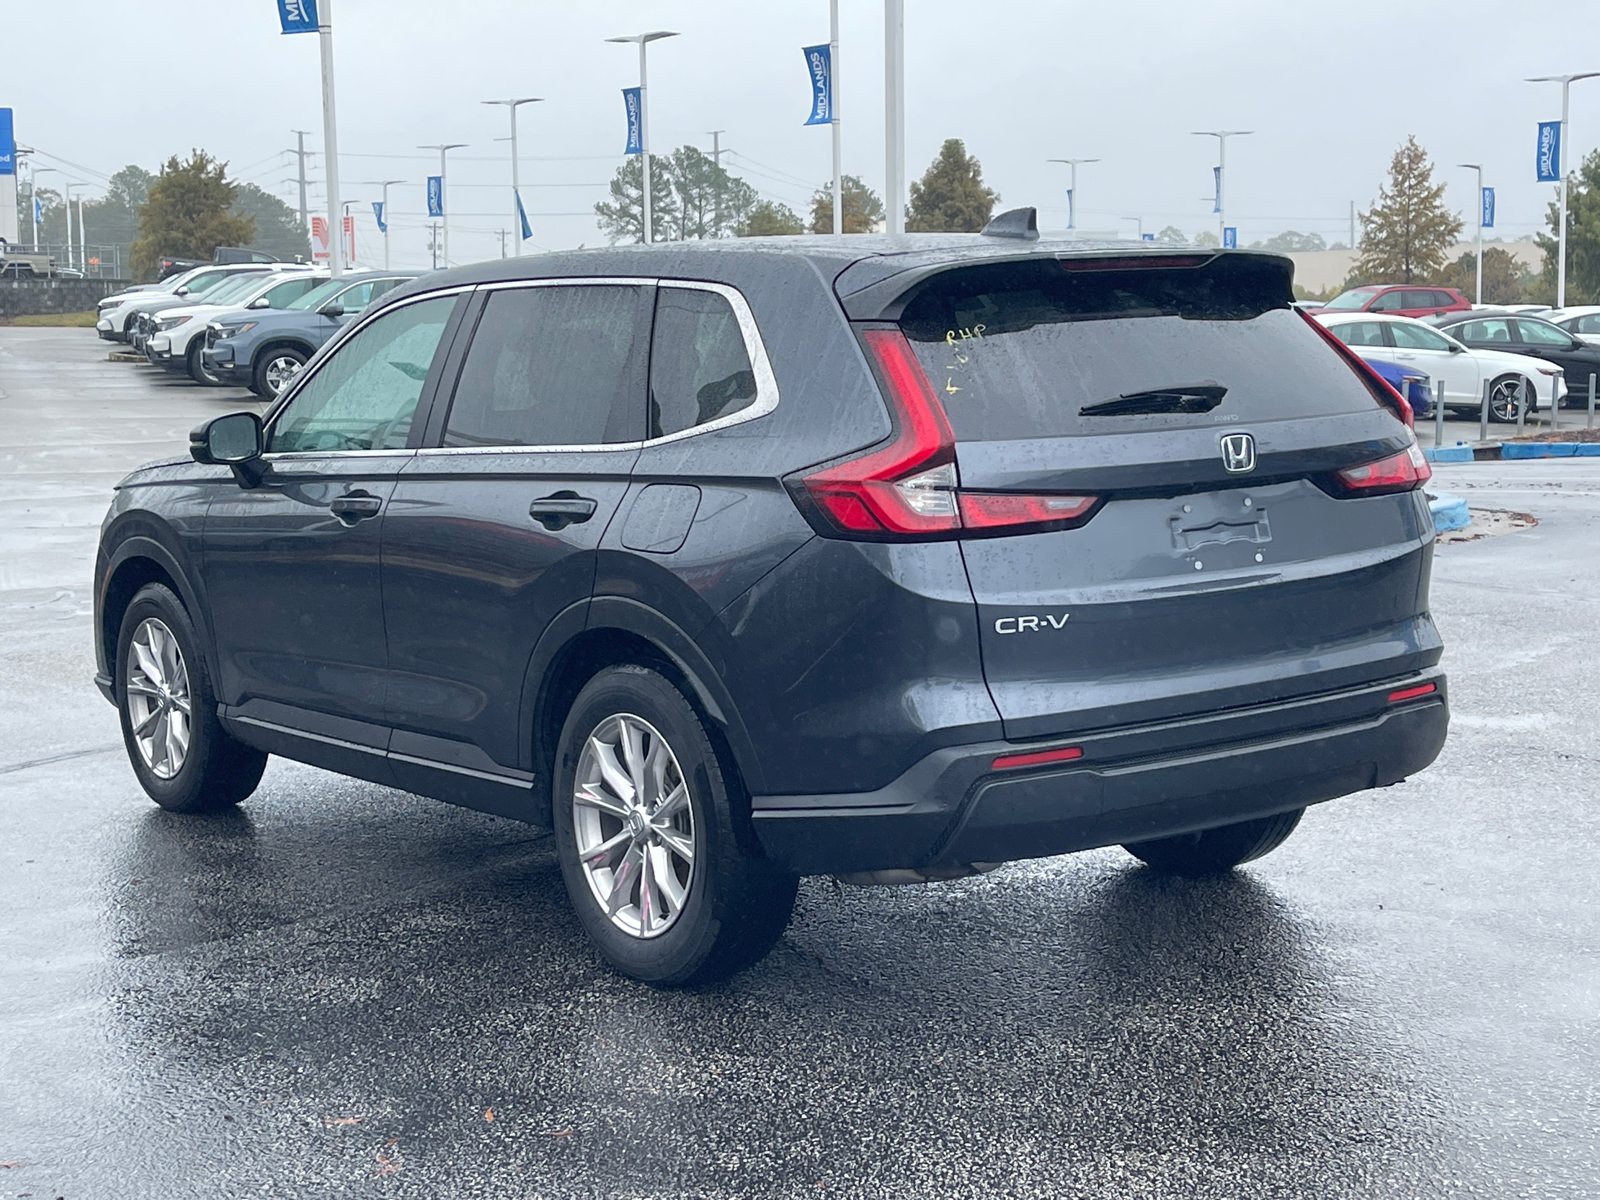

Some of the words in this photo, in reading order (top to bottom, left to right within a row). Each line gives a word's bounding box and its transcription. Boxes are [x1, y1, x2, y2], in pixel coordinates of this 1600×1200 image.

[810, 52, 826, 119] MIDLANDS
[627, 93, 637, 148] MIDLANDS
[1541, 126, 1551, 176] MIDLANDS
[1214, 414, 1239, 422] AWD
[995, 613, 1070, 634] CR-V
